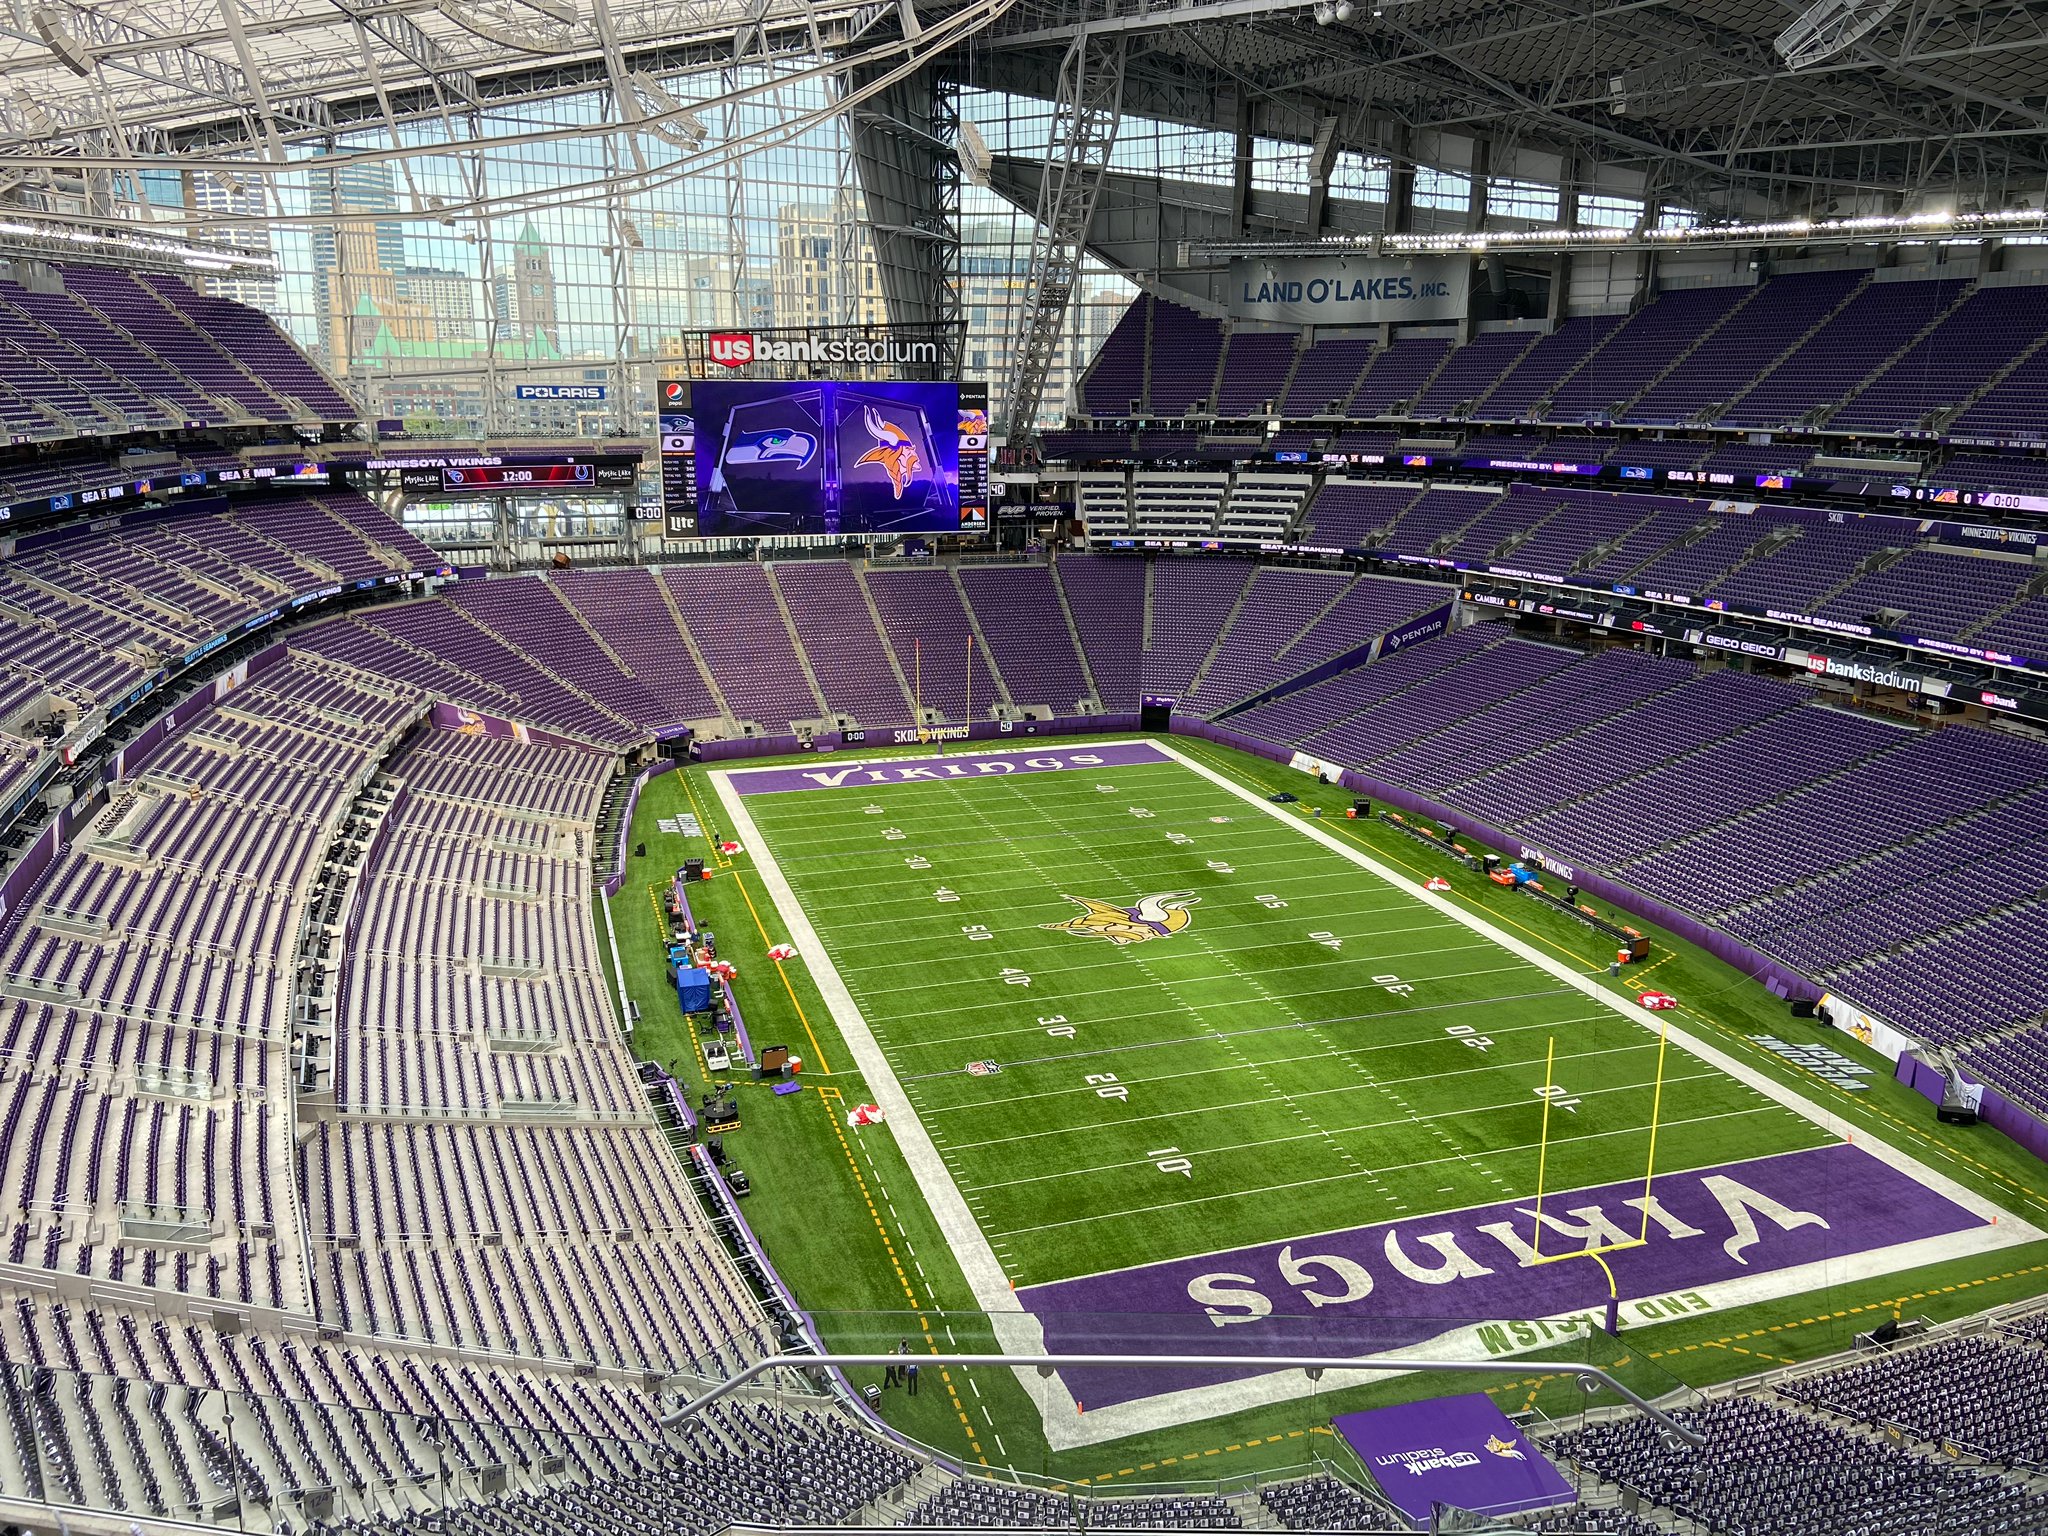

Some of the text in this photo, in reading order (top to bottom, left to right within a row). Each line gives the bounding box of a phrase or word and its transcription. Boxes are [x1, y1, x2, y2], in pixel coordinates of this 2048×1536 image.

[1243, 281, 1302, 303] LAND
[1421, 282, 1450, 298] INC.
[522, 388, 600, 398] POLARIS
[1950, 438, 1975, 446] MINNESOTA
[367, 458, 502, 469] MINNESOTA VIKINGS
[1322, 454, 1348, 462] SEA
[1362, 455, 1384, 463] MIN
[1490, 461, 1538, 469] PRESENTED
[218, 470, 241, 482] SEA
[254, 468, 276, 478] MIN
[503, 471, 532, 482] 12:00
[1668, 471, 1694, 481] SEA
[1710, 474, 1734, 484] MIN
[82, 492, 100, 503] SEA
[108, 486, 124, 498] MIN
[991, 484, 1004, 495] 40
[1916, 489, 1924, 500] 0
[1964, 494, 1972, 504] 0
[1994, 496, 2020, 508] 0:00
[636, 508, 661, 519] 0:00
[1828, 512, 1844, 523] SKOL
[670, 516, 694, 532] Lite
[1962, 526, 2037, 544] MINNESOTA VIKINGS
[1299, 545, 1344, 554] SEAHAWKS
[384, 572, 424, 584] SEA MIN
[1489, 566, 1564, 583] MINNESOTA VIKINGS
[292, 586, 342, 608] MINNESOTA VIKINGS
[1475, 593, 1505, 606] CAMBRIA
[1645, 590, 1663, 600] SEA
[1673, 595, 1690, 604] MIN
[1767, 610, 1872, 635] SEATTLE SEAHAWKS
[1402, 621, 1442, 642] PENTAIR
[184, 634, 228, 665] SEATTLE SEAHAWKS
[1706, 633, 1776, 656] GEICO GEICO
[1918, 638, 1969, 654] PRESENTED
[1970, 647, 1984, 656] BY:
[1981, 692, 2018, 710] usbank
[660, 726, 684, 735] LUMEN
[847, 732, 865, 741] 0:00
[894, 727, 970, 743] SKOL VIKINGS
[802, 754, 1104, 787] VIKINGS
[1096, 785, 1119, 794] 10
[861, 806, 884, 815] 10
[1128, 807, 1156, 818] 20
[881, 828, 907, 841] 20
[1165, 832, 1195, 844] 30
[905, 856, 932, 870] 30
[1207, 860, 1236, 874] 40
[1545, 857, 1574, 880] VIKINGS
[933, 890, 961, 902] 40
[1254, 894, 1289, 909] 50
[962, 925, 994, 941] 50
[1308, 931, 1344, 947] 40
[998, 968, 1032, 985] 40
[1371, 975, 1415, 994] 30
[1037, 1015, 1076, 1037] 30
[1445, 1025, 1495, 1048] 20
[1744, 1034, 1870, 1090] WELCOME
[1792, 1044, 1875, 1074] BACK
[1084, 1073, 1129, 1098] 20
[1533, 1085, 1583, 1108] 10
[1147, 1147, 1192, 1173] 10
[343, 1240, 356, 1248] 127
[487, 1236, 499, 1244] 127
[1187, 1175, 1830, 1327] VIKINGS
[1635, 1292, 1712, 1319] END
[323, 1331, 340, 1340] 124
[579, 1367, 594, 1376] 124
[649, 1375, 663, 1383] 124
[1888, 1426, 1900, 1440] 120
[1375, 1448, 1446, 1466] stadium
[1944, 1443, 1958, 1458] 120
[549, 1460, 563, 1472] 124
[1404, 1452, 1482, 1476] usbank
